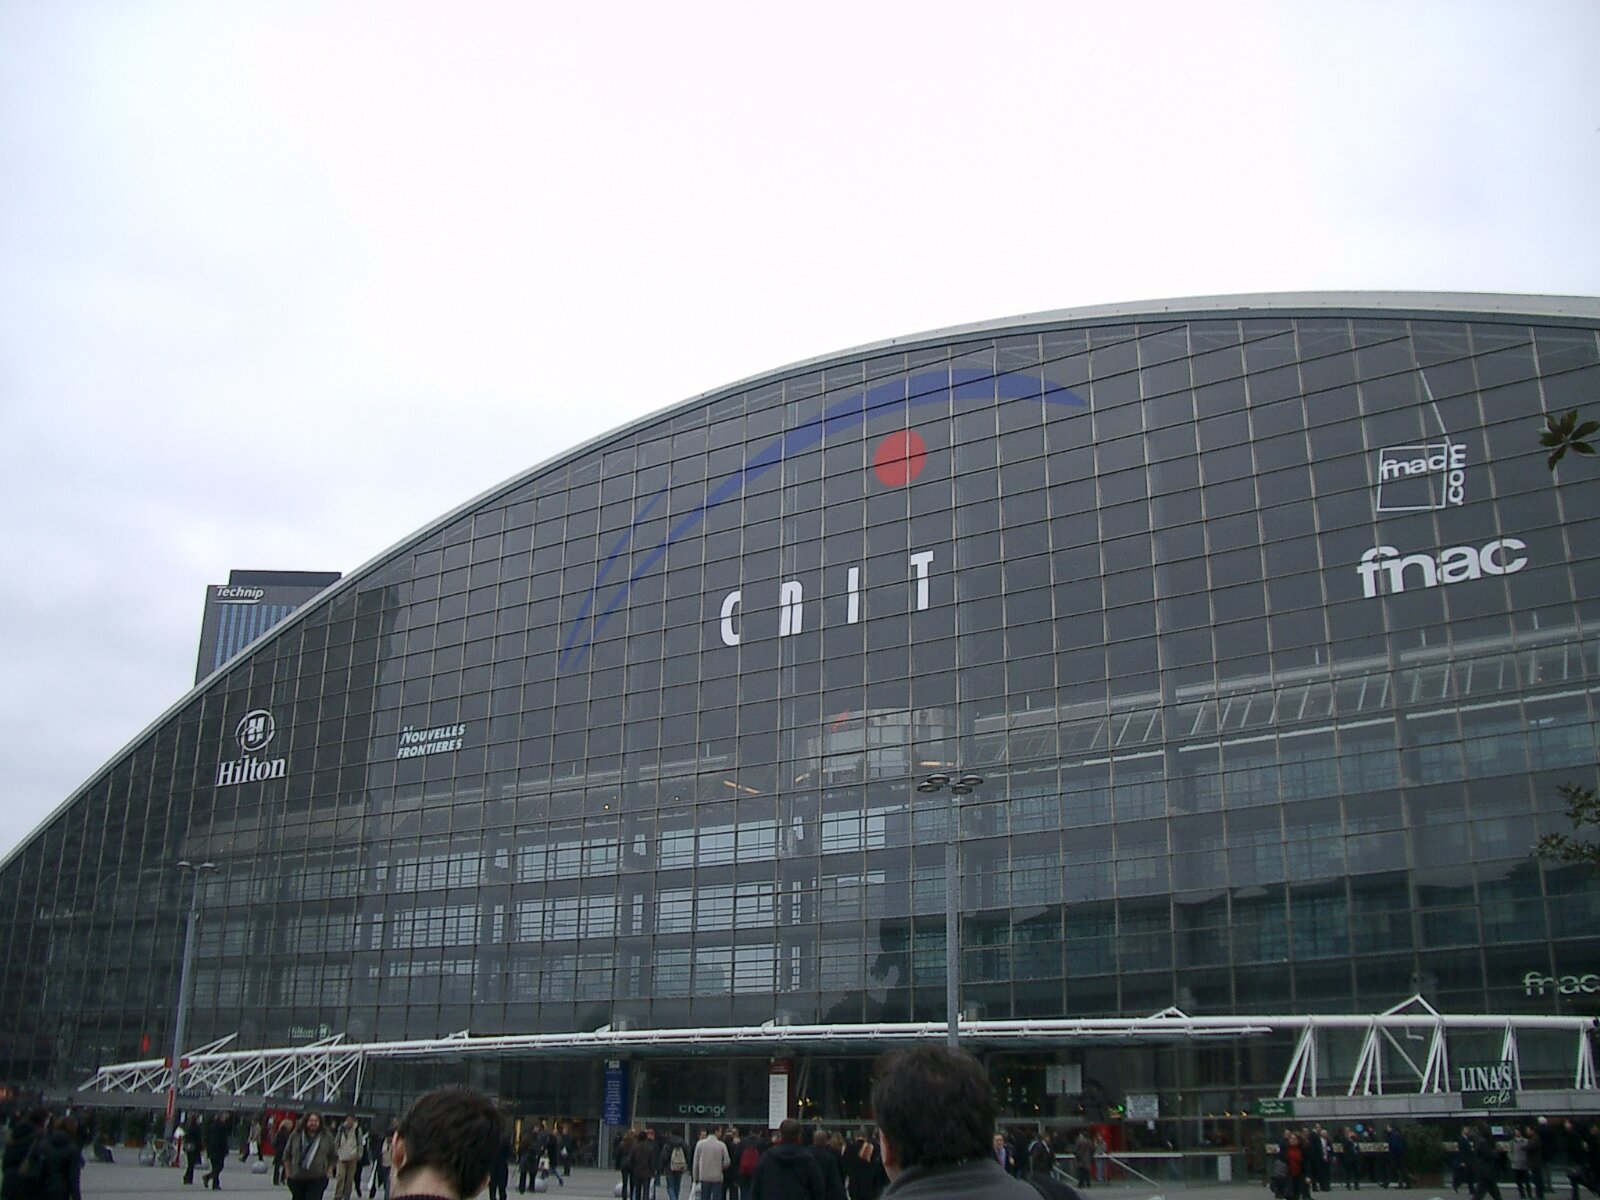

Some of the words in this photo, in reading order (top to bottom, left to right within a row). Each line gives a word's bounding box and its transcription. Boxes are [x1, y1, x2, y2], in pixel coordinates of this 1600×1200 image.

[1381, 454, 1445, 480] fnac
[1357, 538, 1528, 598] fnac
[217, 585, 264, 599] Technip
[400, 724, 465, 745] NOUVELLES
[397, 738, 463, 759] FRONTIERES
[215, 755, 286, 787] Hilton
[1523, 971, 1600, 995] fnac
[1459, 1065, 1512, 1091] LINA'S
